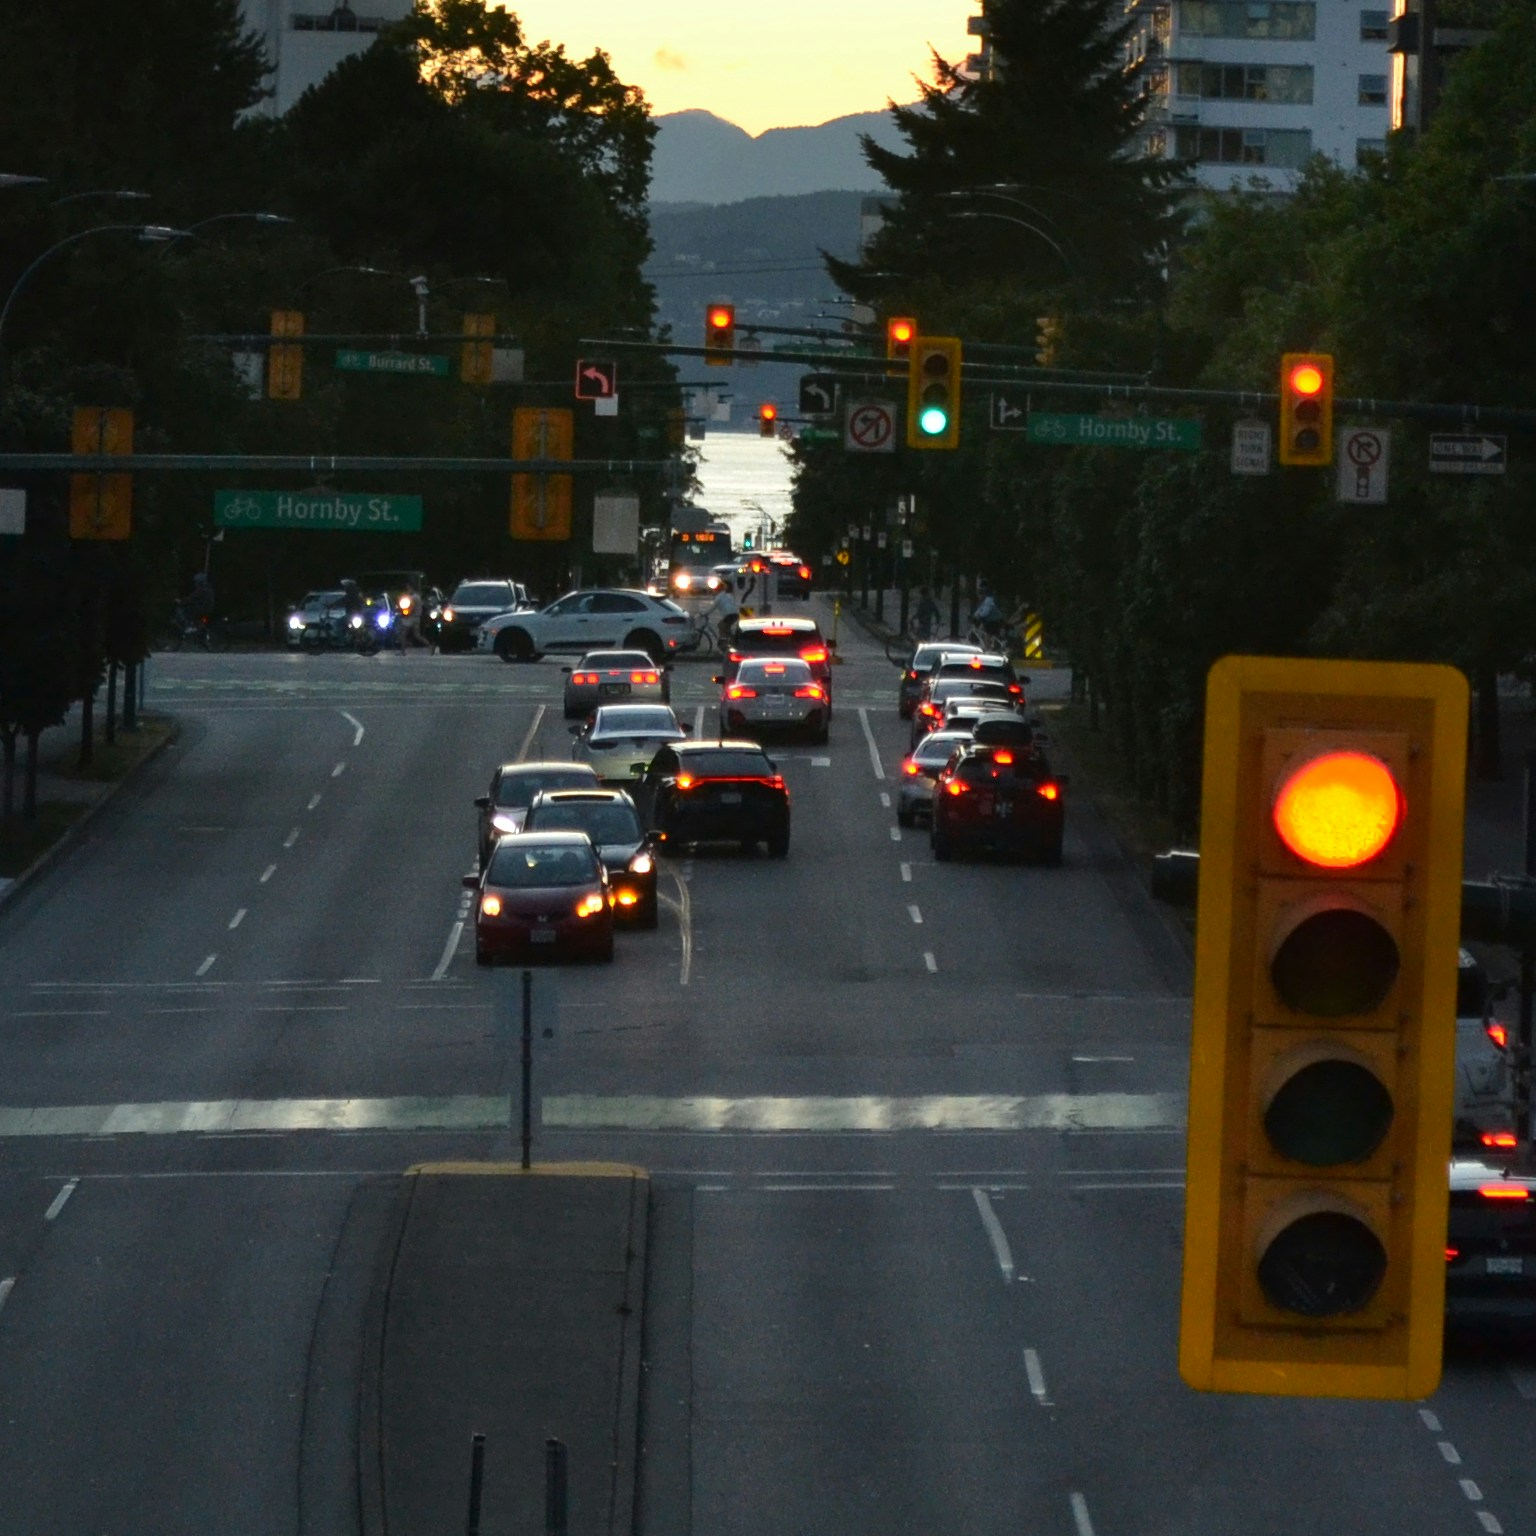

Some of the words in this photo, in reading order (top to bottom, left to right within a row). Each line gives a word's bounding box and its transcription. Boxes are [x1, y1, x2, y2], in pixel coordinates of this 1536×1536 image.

[368, 354, 416, 371] Burrard
[1078, 417, 1151, 444] Hornby
[1156, 421, 1182, 442] St.
[1237, 430, 1265, 441] RIGHT
[1240, 443, 1263, 454] TURN
[1434, 443, 1457, 455] ONE
[1235, 457, 1266, 468] SIGNAL
[277, 495, 363, 526] Hornby
[368, 499, 400, 523] St.
